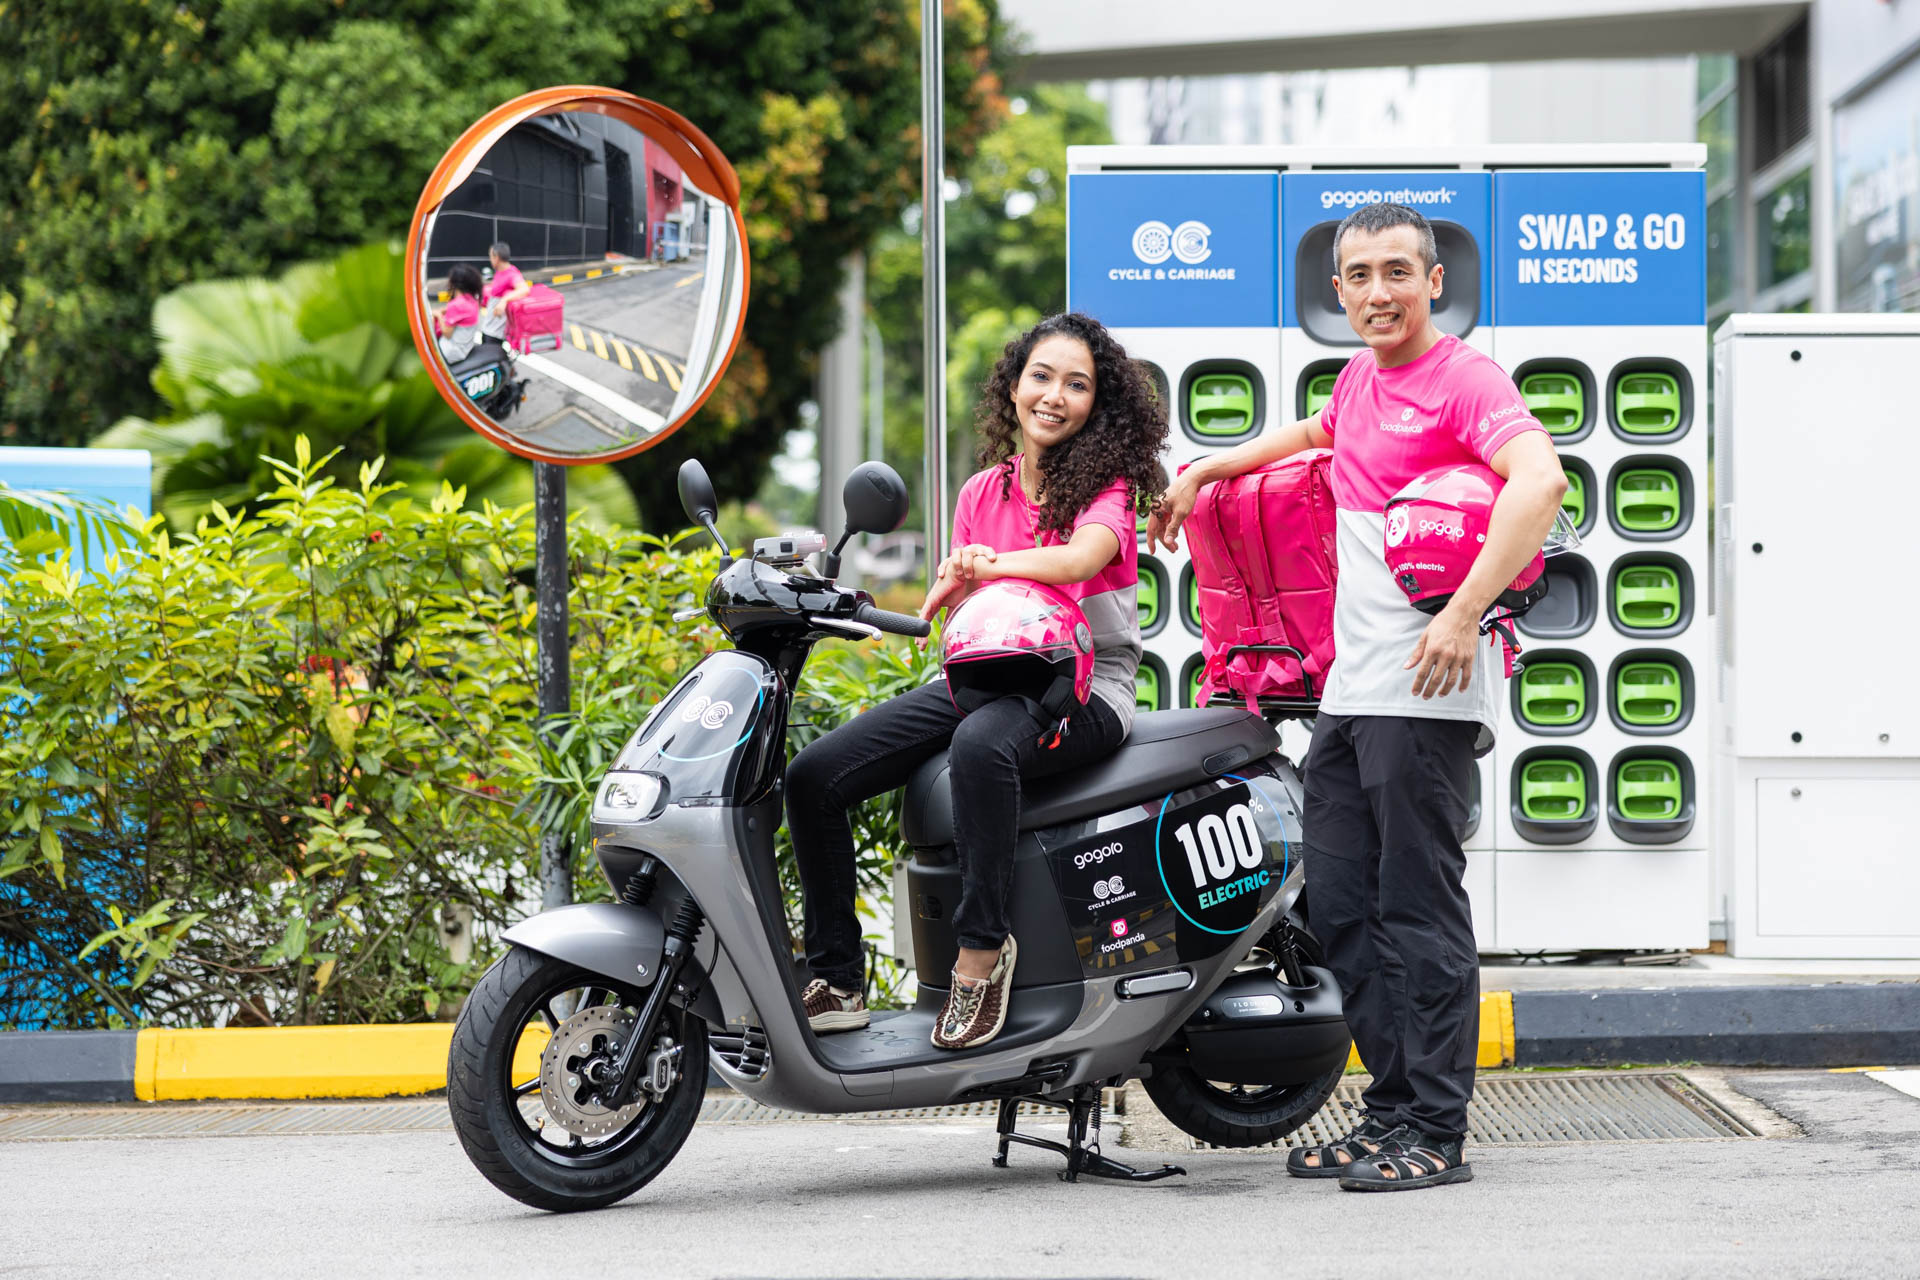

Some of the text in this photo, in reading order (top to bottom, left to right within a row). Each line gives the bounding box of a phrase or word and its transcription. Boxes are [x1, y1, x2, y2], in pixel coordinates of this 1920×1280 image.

[1321, 191, 1382, 208] gogoro
[1518, 213, 1686, 250] SWAP & GO
[1108, 268, 1236, 280] CYCLE & CARRIAGE
[1518, 257, 1638, 284] IN SECONDS
[1419, 519, 1465, 538] gogoro
[1415, 562, 1446, 573] electric
[1074, 842, 1123, 869] gogoro
[1198, 869, 1270, 910] ELECTRIC
[1088, 899, 1106, 911] CYCLE
[1111, 890, 1137, 904] CARRIAGE
[1101, 932, 1146, 954] foodpanda
